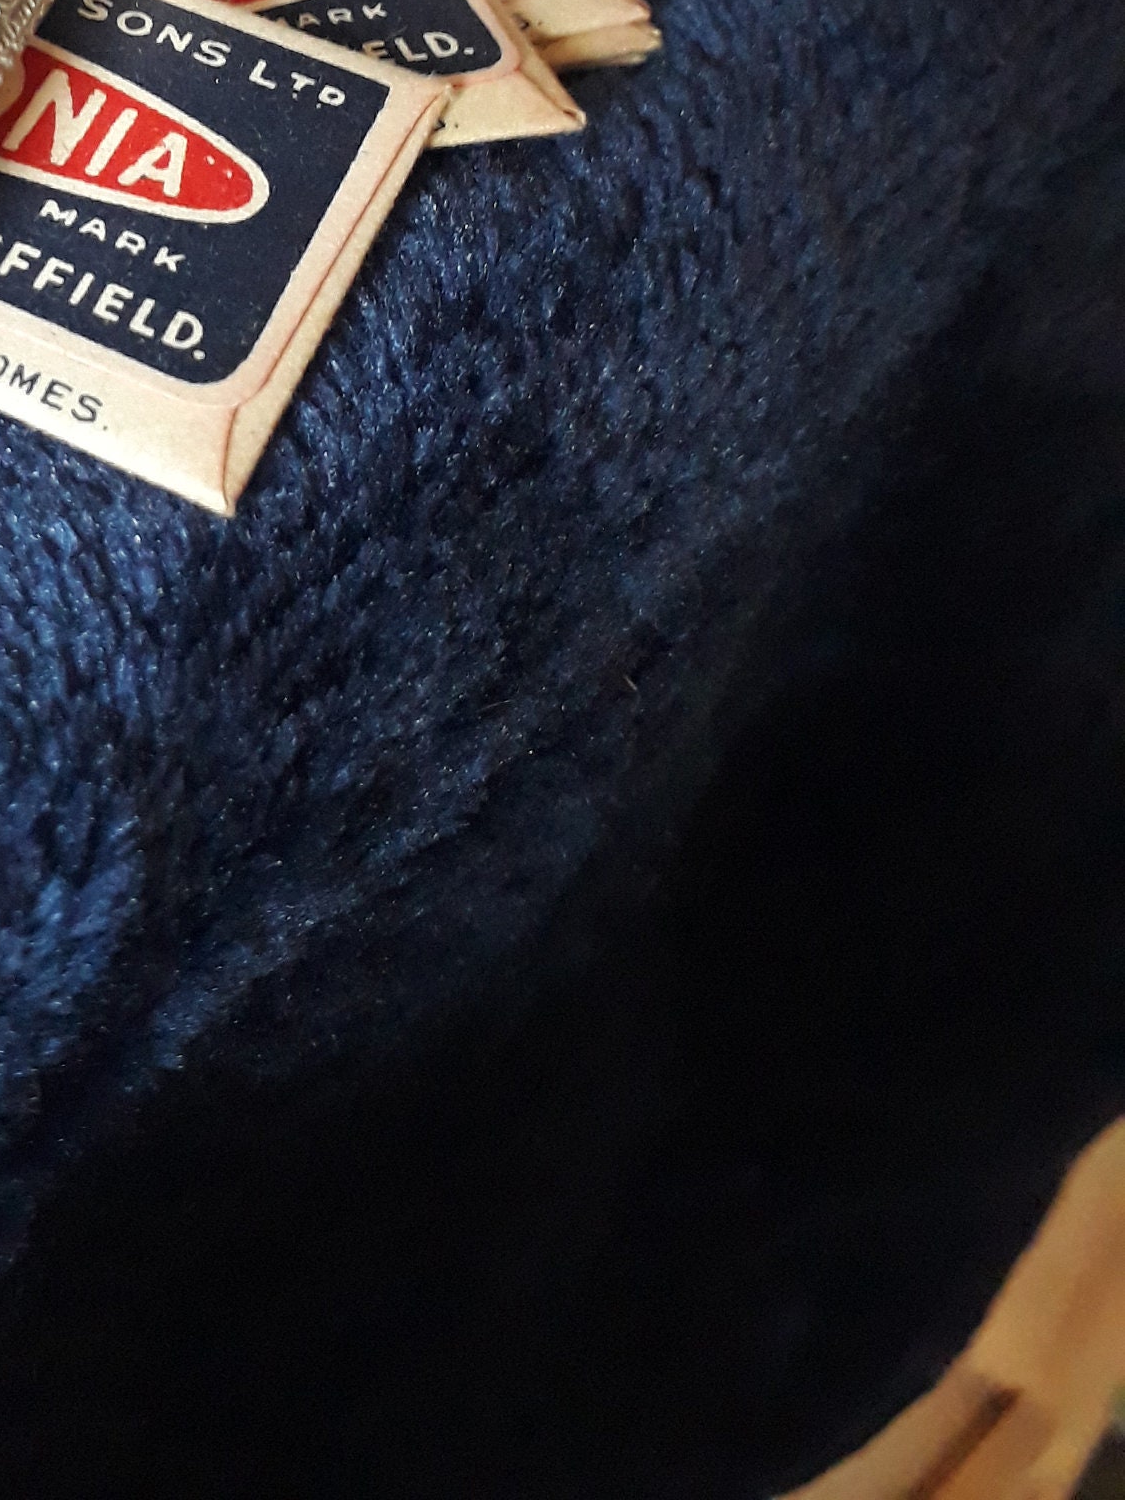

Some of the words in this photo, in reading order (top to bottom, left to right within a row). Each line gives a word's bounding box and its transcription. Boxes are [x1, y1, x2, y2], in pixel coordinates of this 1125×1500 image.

[274, 0, 388, 30] ARK
[247, 57, 349, 110] LTD
[37, 198, 188, 274] MARK
